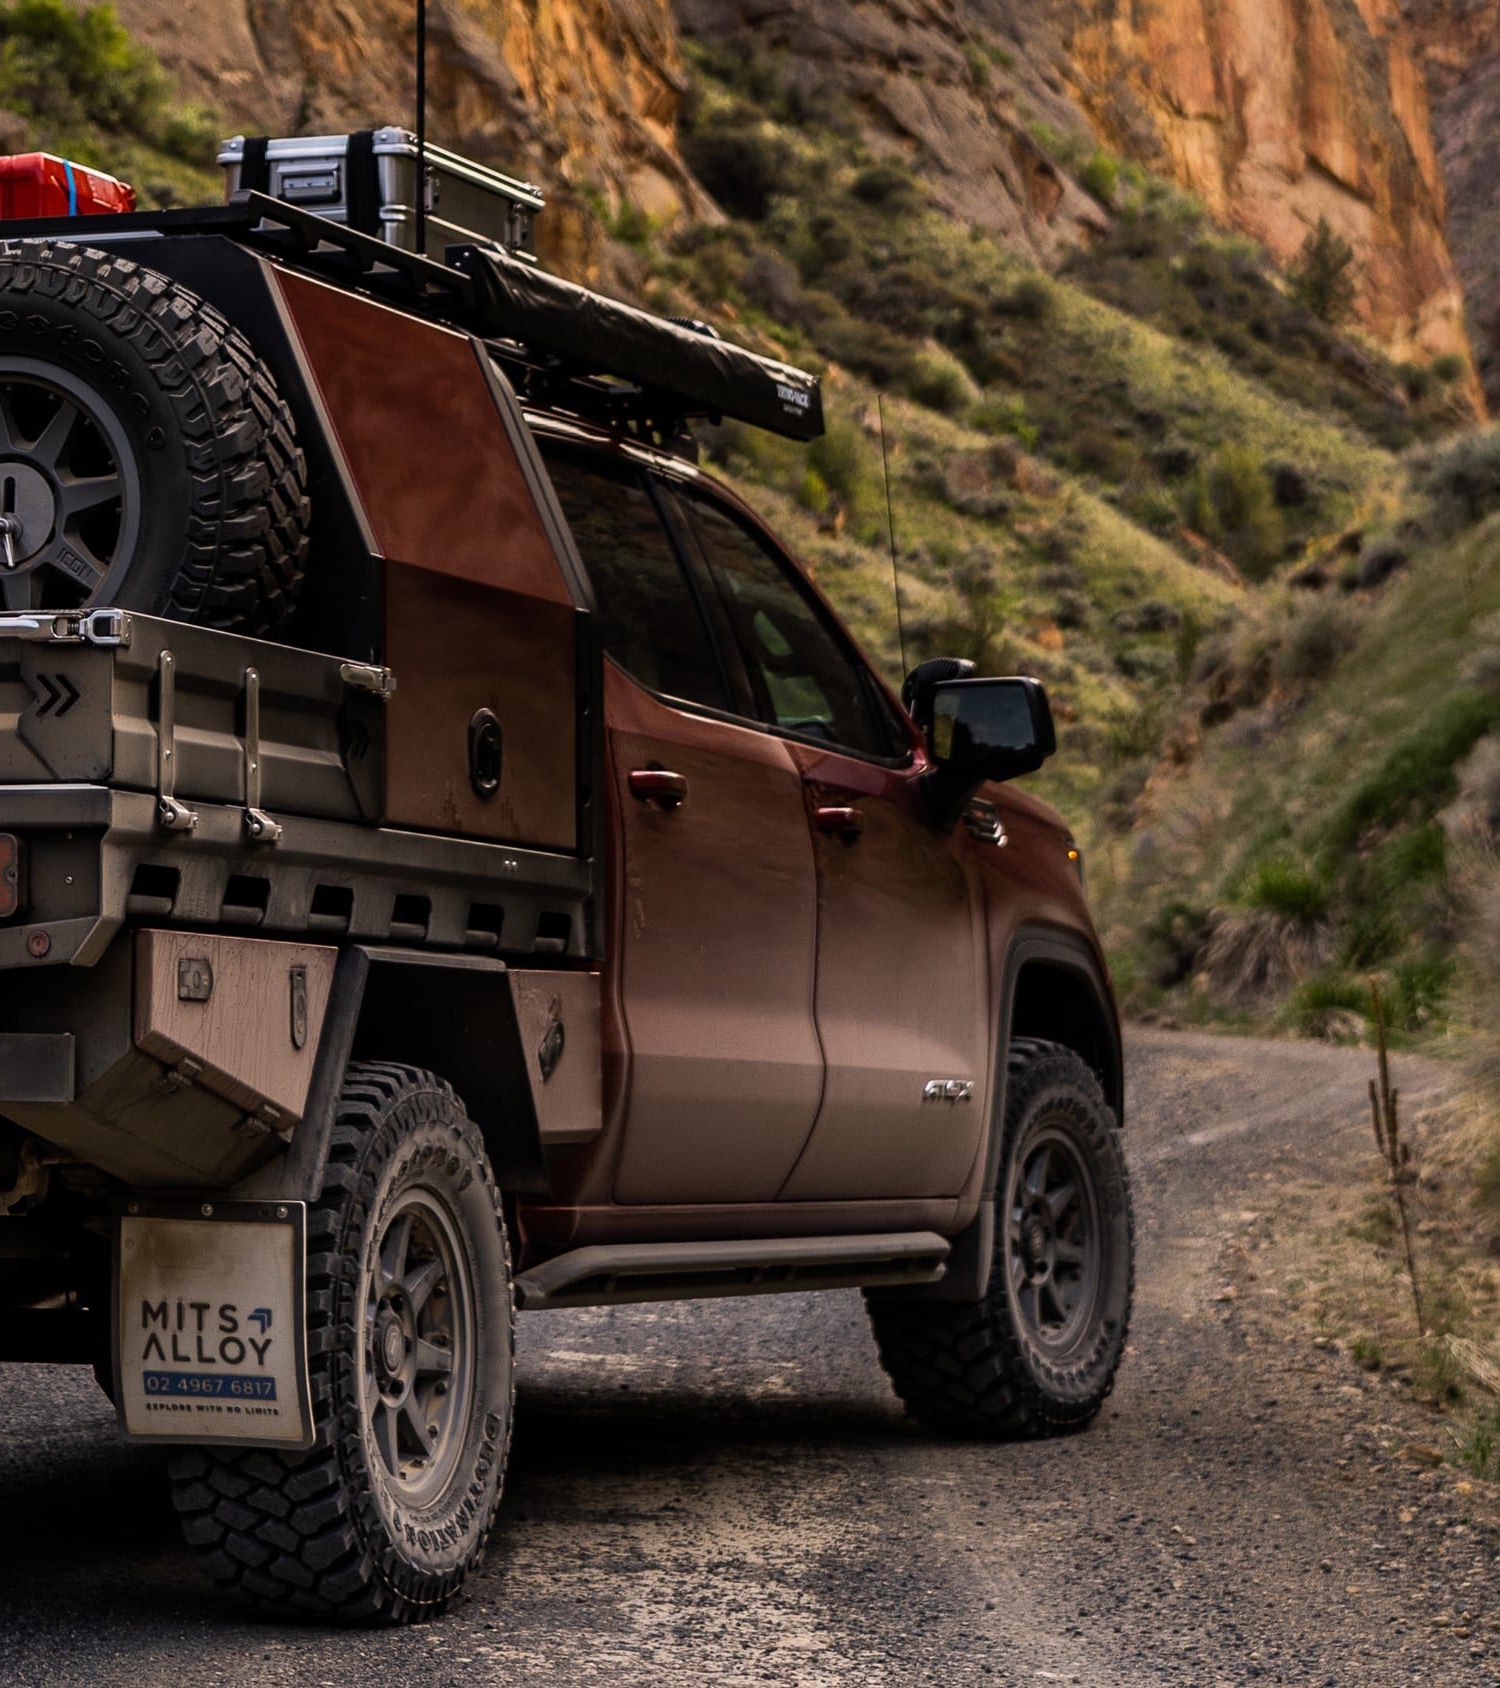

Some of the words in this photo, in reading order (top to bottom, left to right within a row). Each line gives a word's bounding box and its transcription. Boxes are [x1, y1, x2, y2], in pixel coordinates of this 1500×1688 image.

[56, 547, 94, 577] ICON
[141, 1299, 239, 1334] MITS
[142, 1332, 273, 1366] ALLOY
[147, 1376, 170, 1391] 02
[177, 1378, 224, 1393] 4967
[230, 1380, 273, 1396] 6817
[146, 1403, 192, 1413] EXPLORE
[196, 1404, 223, 1413] WITH
[226, 1405, 241, 1414] NO
[245, 1407, 280, 1416] LIMITS
[404, 1411, 501, 1552] DESTINATION
